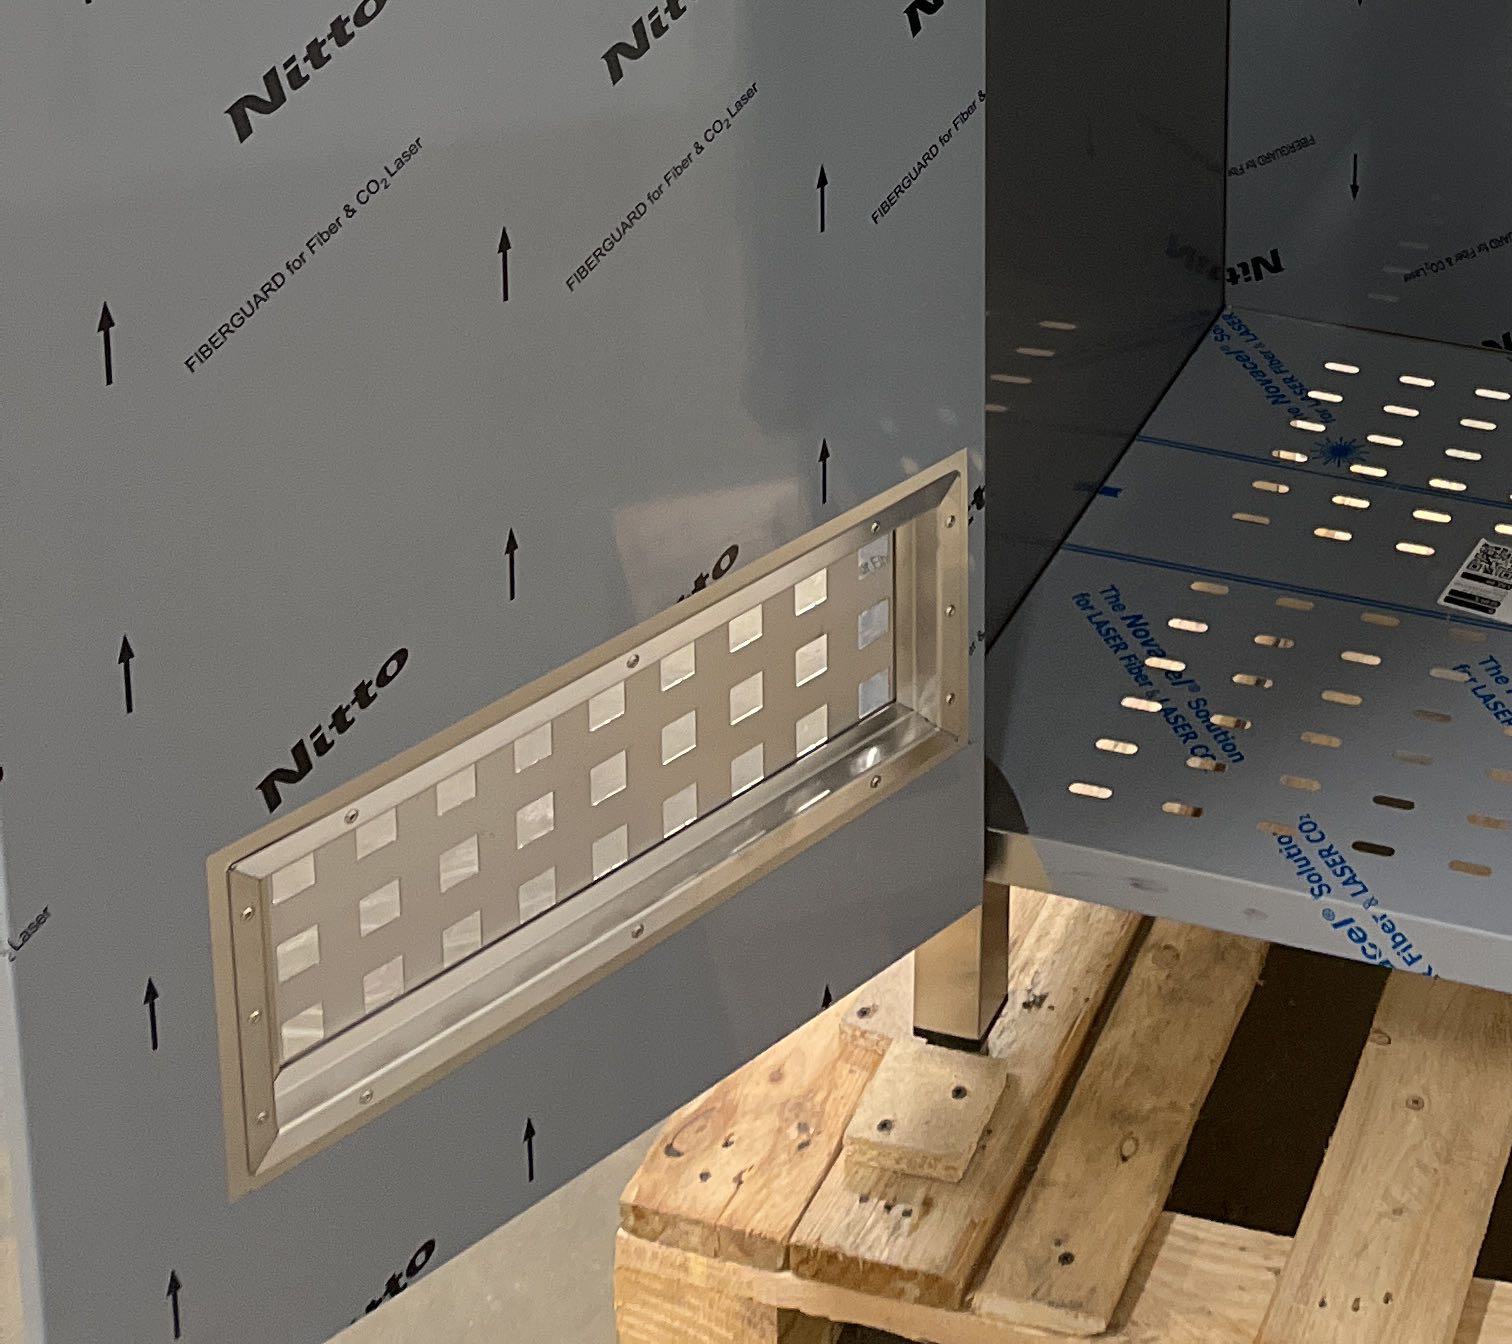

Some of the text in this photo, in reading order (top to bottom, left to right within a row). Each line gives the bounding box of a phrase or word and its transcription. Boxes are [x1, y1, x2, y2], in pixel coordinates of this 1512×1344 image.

[871, 90, 985, 224] FIBERGUARD for Fiber &
[566, 202, 647, 292] FIBERGUARD
[647, 184, 663, 204] for
[664, 153, 693, 187] Fiber
[693, 141, 705, 155] &
[726, 82, 757, 118] Laser
[184, 272, 285, 373] FIBERGUARD
[286, 252, 306, 275] for
[306, 217, 342, 255] Fiber
[343, 204, 357, 218] &
[384, 137, 422, 177] Laser
[1228, 249, 1284, 285] Nit
[1259, 349, 1289, 375] Fiber
[1099, 584, 1127, 613] The
[1072, 591, 1153, 687] for LASER Fiber
[1478, 654, 1510, 686] The
[256, 648, 408, 813] Nitto
[1318, 843, 1369, 898] LASER
[8, 905, 51, 952] Laser
[1372, 913, 1423, 967] Fiber
